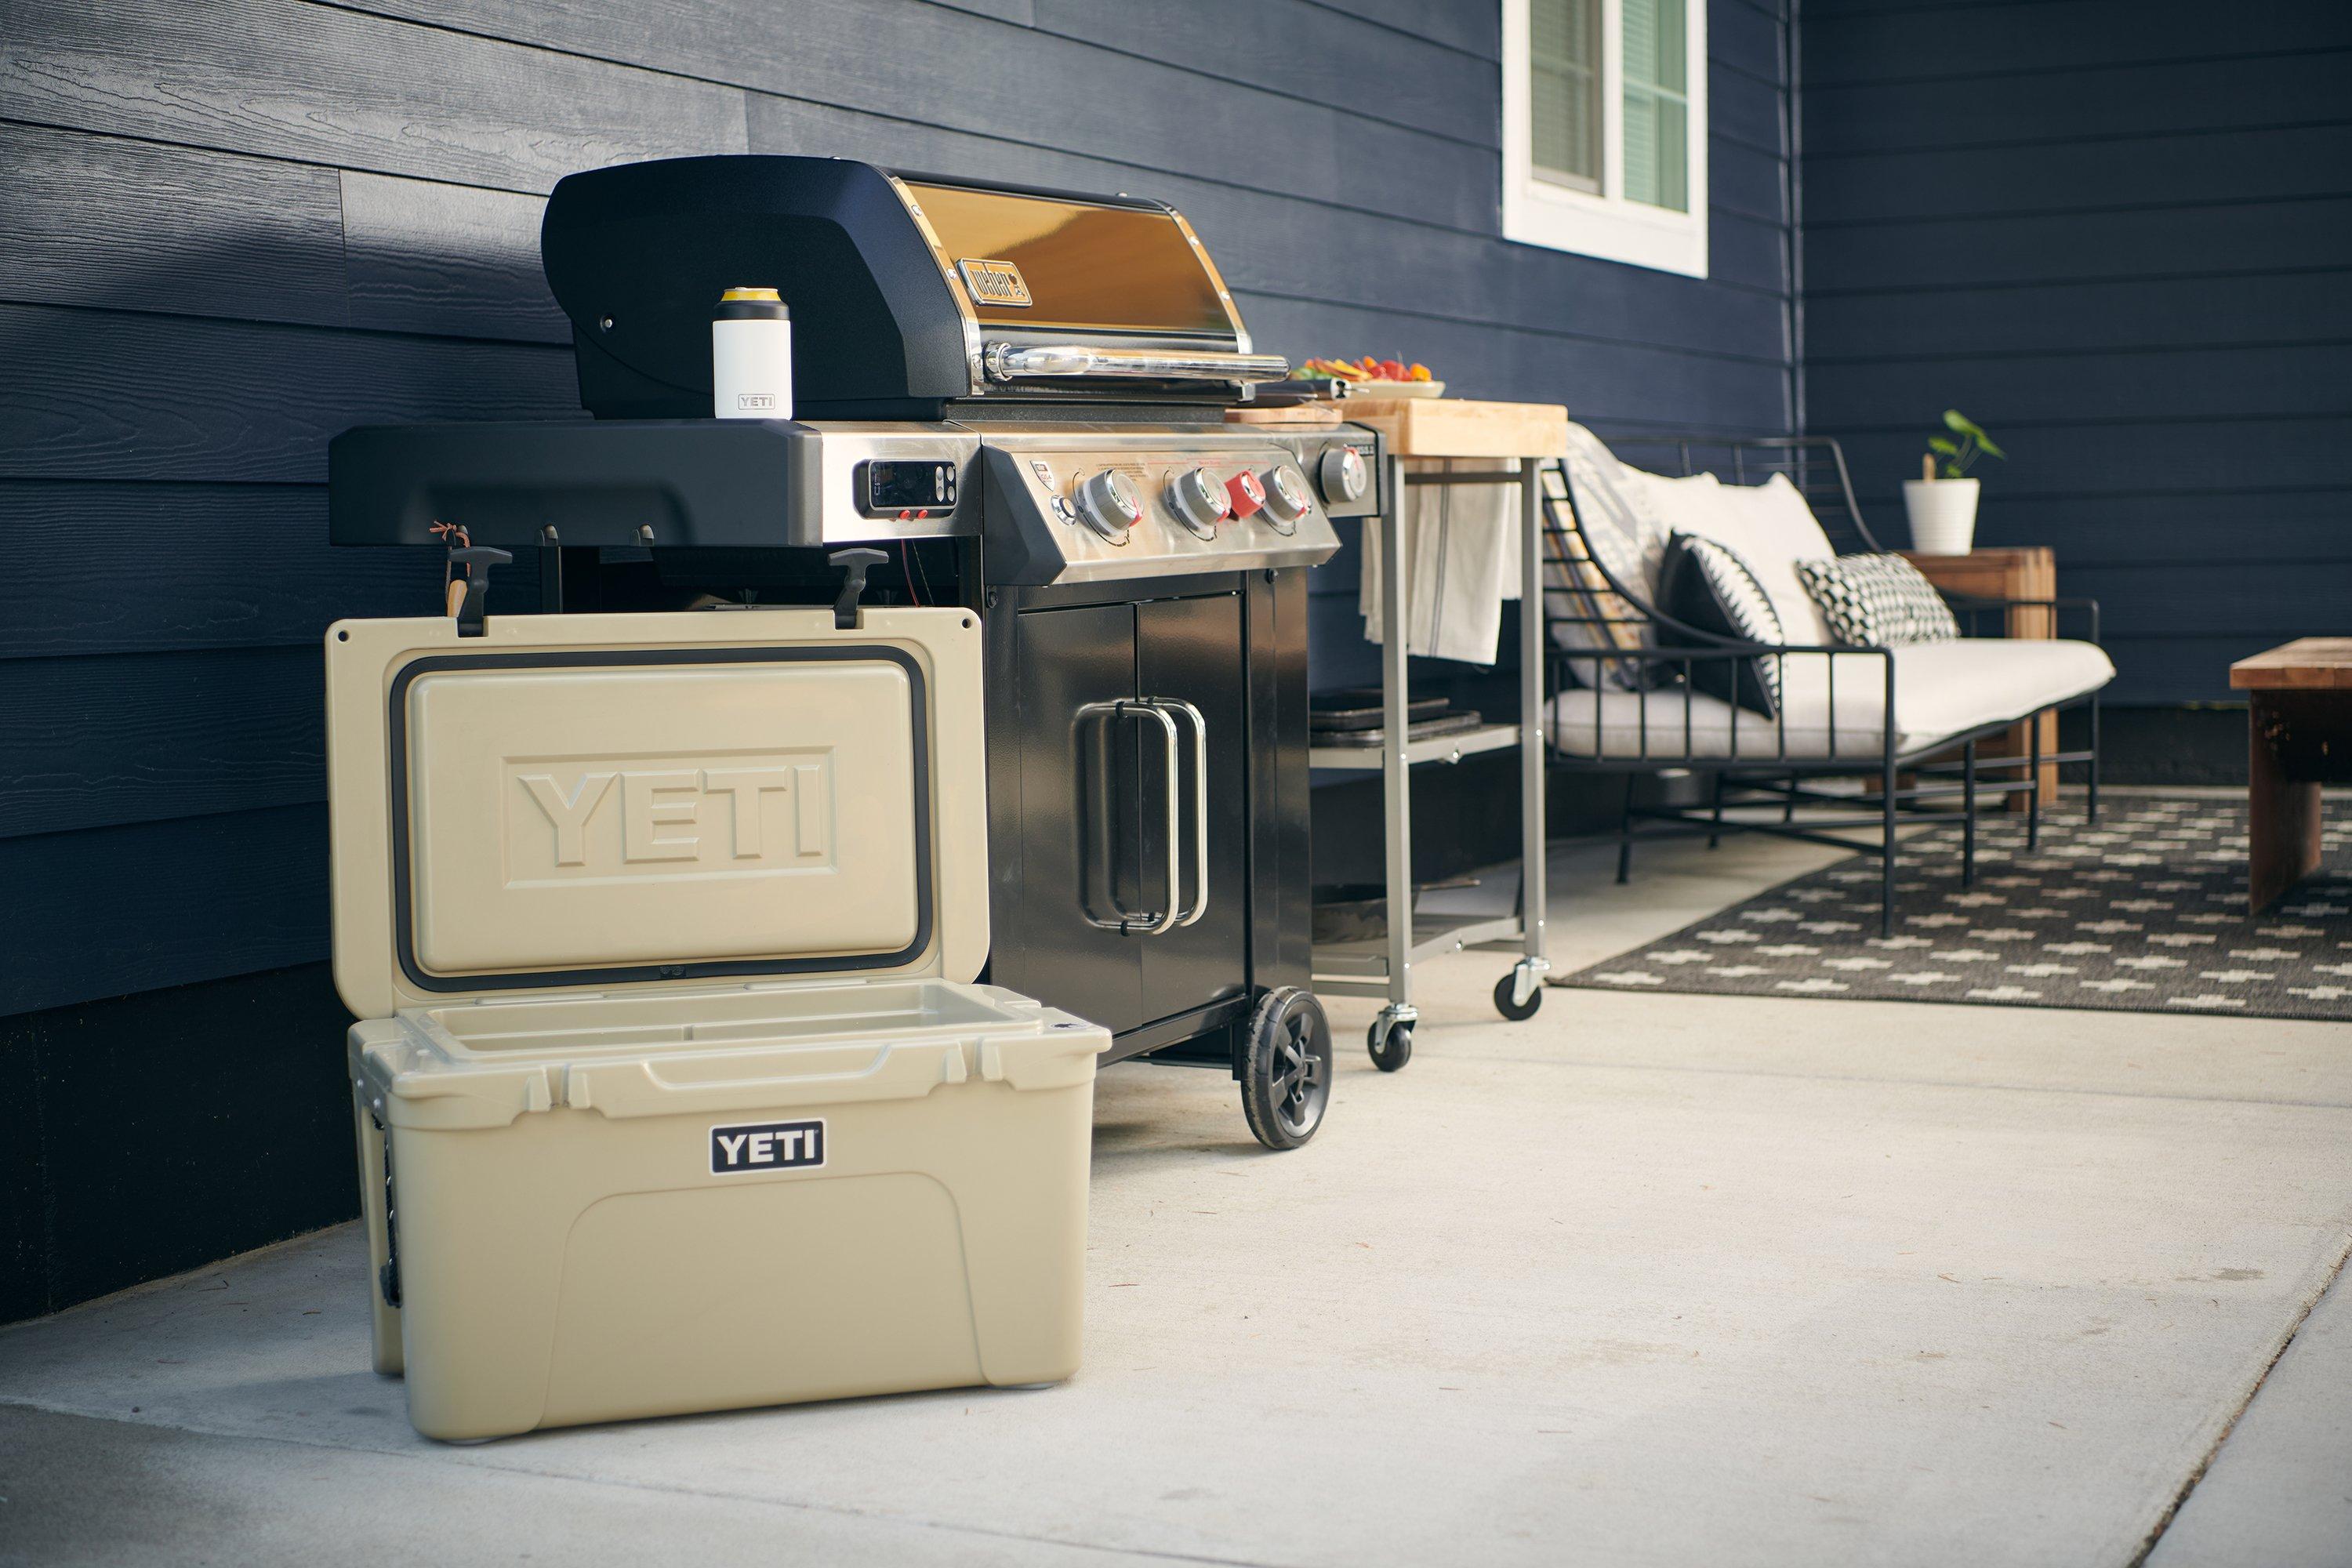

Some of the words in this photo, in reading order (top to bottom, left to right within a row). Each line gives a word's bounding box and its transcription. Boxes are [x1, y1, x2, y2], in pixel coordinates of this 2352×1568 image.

[971, 265, 1013, 296] weber
[741, 397, 772, 406] YETI
[516, 764, 823, 867] YETI
[717, 1129, 815, 1165] YETI
